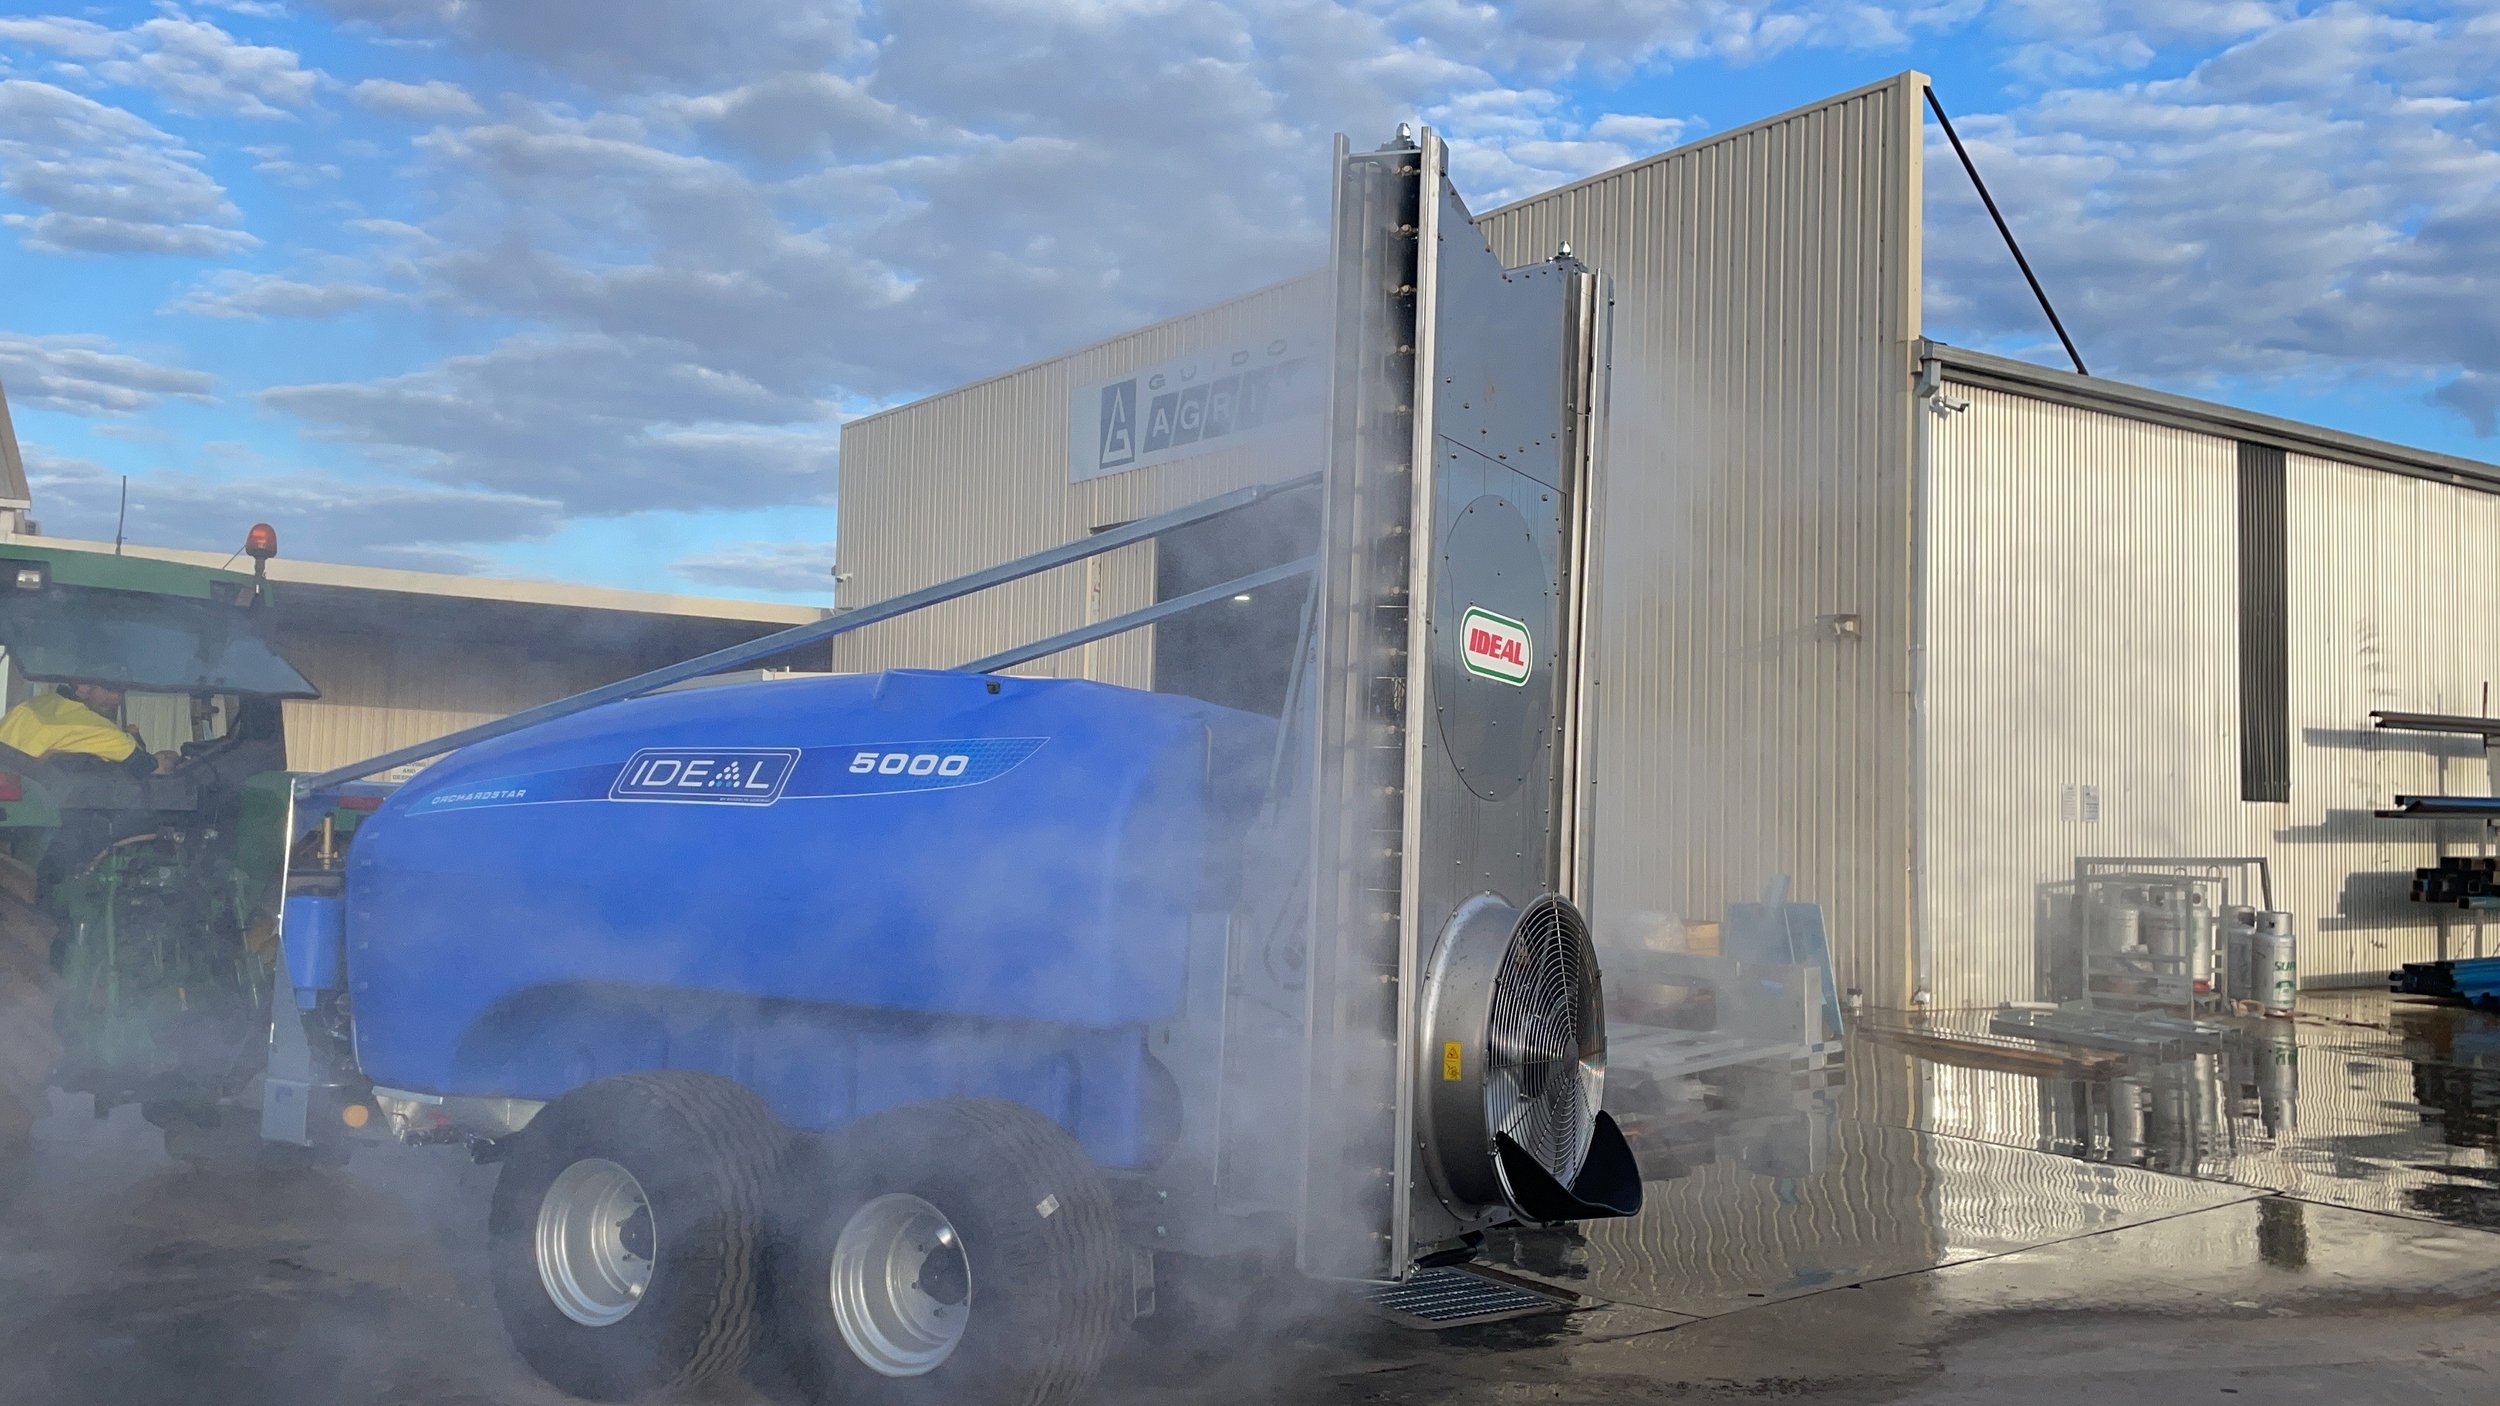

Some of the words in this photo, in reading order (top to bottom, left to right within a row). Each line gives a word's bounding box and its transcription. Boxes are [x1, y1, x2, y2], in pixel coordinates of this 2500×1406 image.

[1469, 628, 1524, 667] IDEAL
[630, 760, 769, 788] IDEAL
[849, 752, 969, 776] 5000
[431, 789, 527, 805] ORCHARDSTAR
